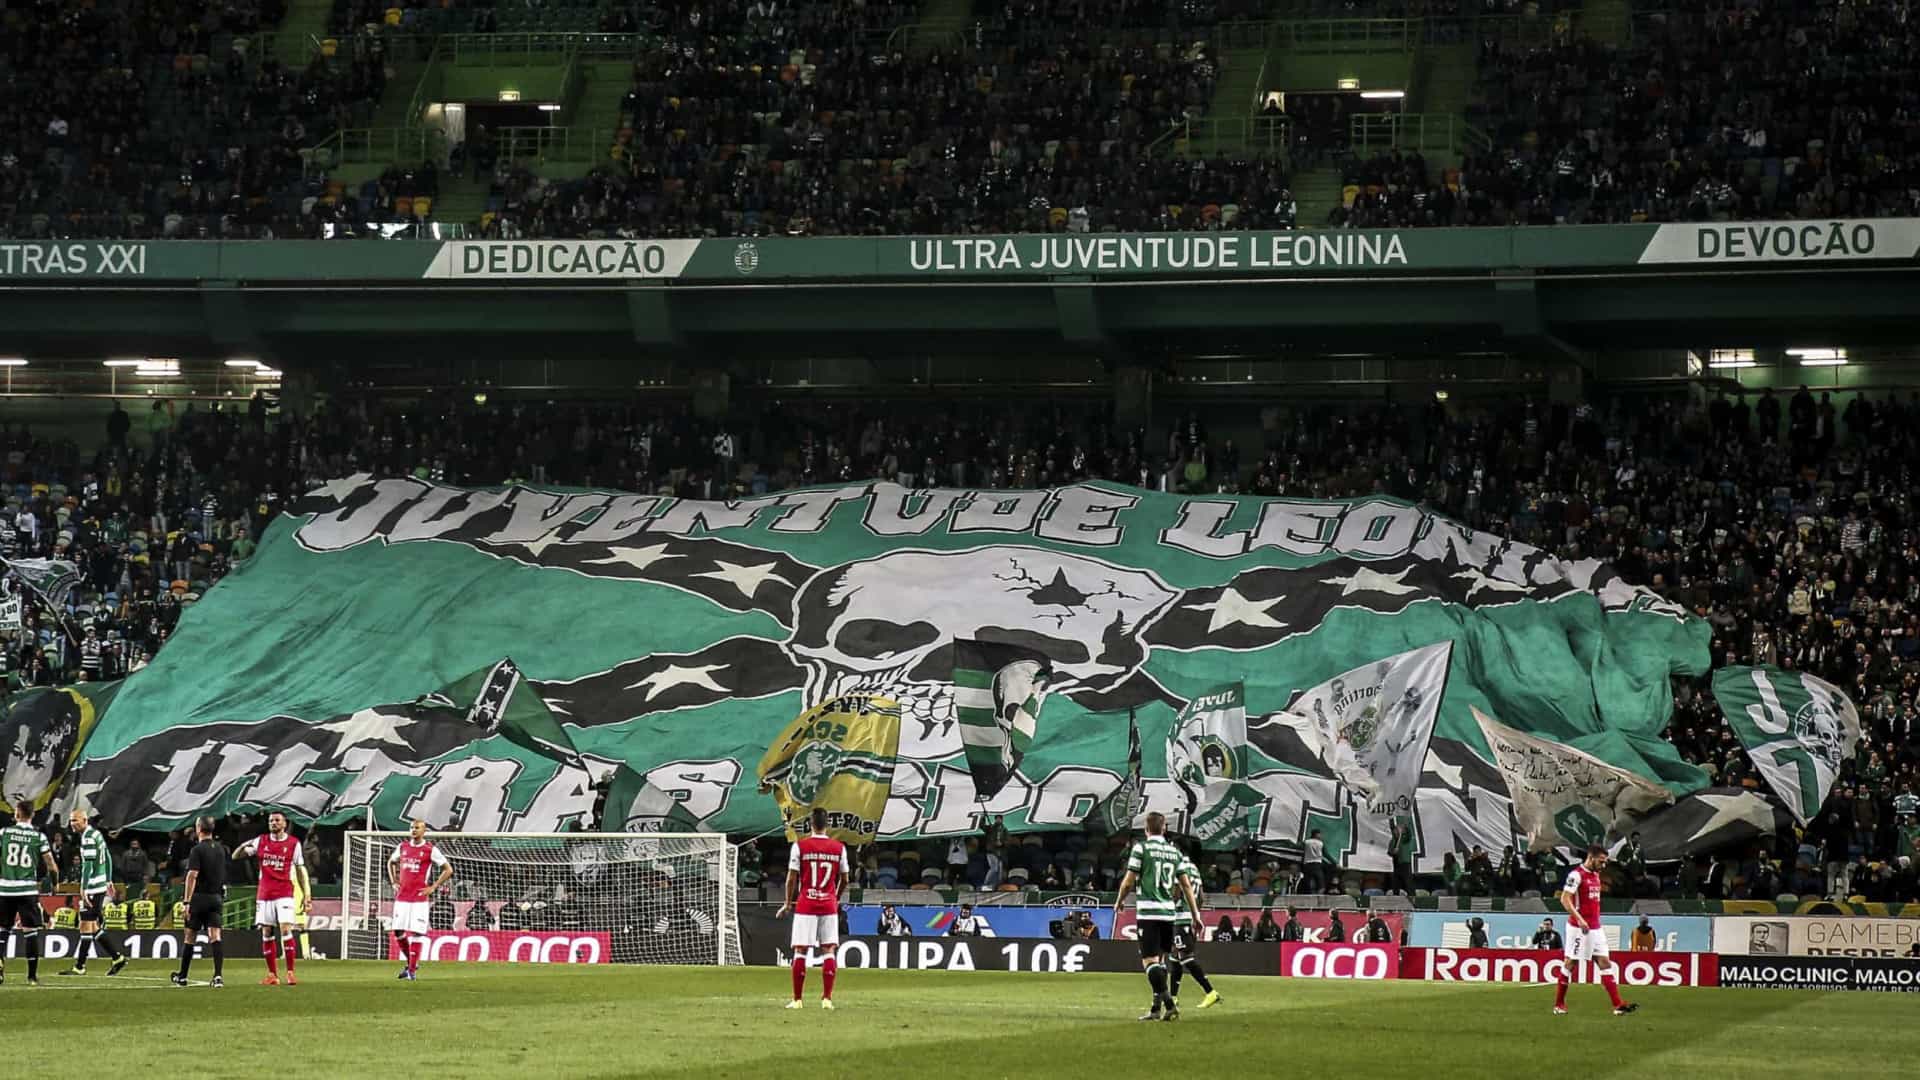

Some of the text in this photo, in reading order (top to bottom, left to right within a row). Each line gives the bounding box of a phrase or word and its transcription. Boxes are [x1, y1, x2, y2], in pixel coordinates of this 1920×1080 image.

[909, 234, 1408, 270] ULTRA JUVENTUDE LEONINA
[1697, 222, 1875, 258] DEVOÇÃO
[0, 244, 146, 274] TRAS XXI
[463, 241, 665, 274] DEDICAÇÃO
[291, 479, 1142, 551] JUVENTUDE
[148, 737, 745, 834] ULTRAS
[7, 842, 32, 868] 86
[810, 861, 832, 888] 17
[1155, 861, 1174, 889] 13
[1807, 922, 1920, 945] GAMEB
[1001, 942, 1091, 972] 10€
[1720, 966, 1848, 984] MALO CLINIC
[1855, 968, 1913, 985] MALO
